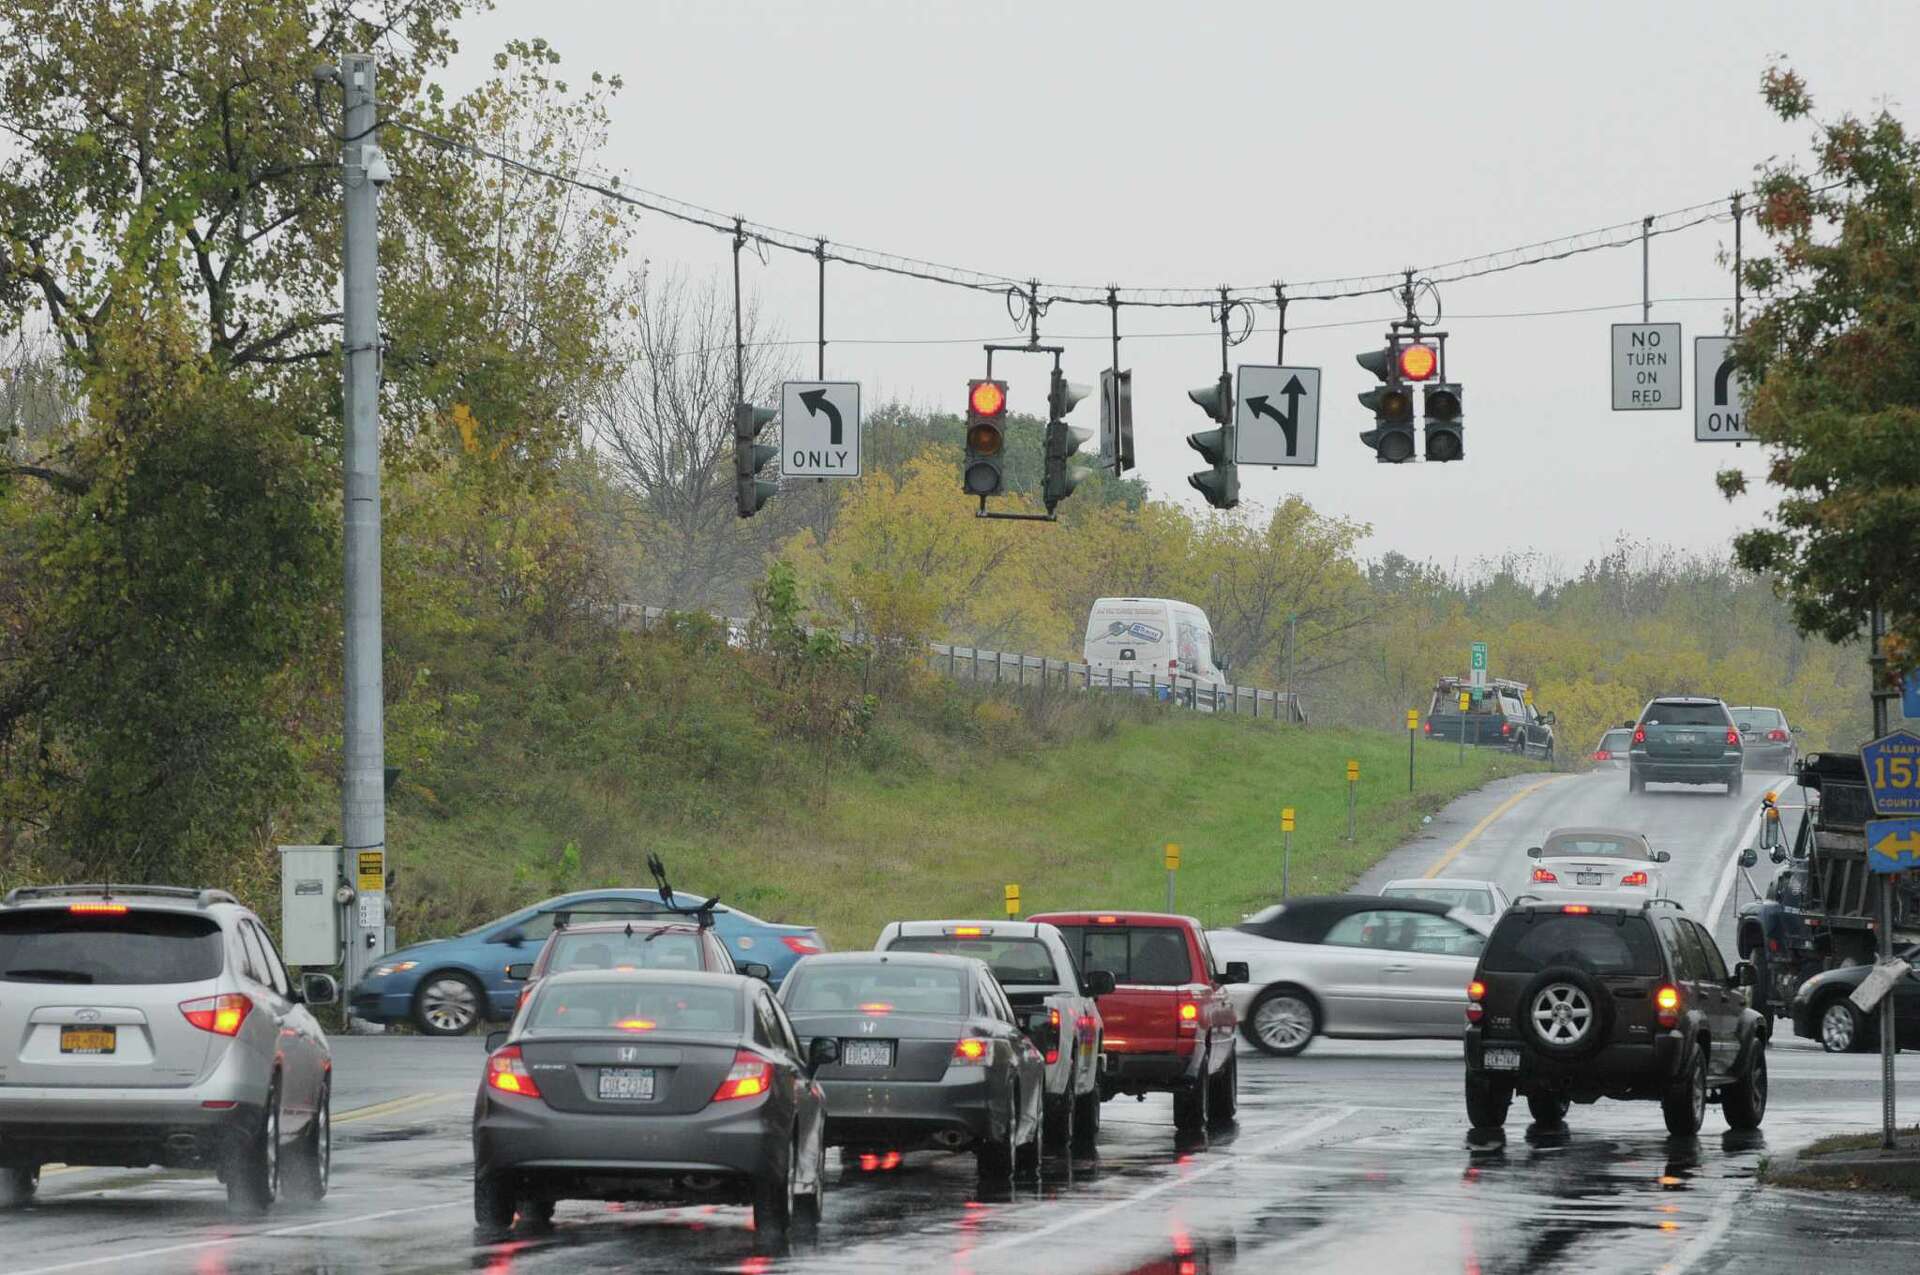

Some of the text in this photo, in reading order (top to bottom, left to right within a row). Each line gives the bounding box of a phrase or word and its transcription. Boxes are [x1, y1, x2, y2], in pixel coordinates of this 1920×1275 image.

[1632, 331, 1661, 347] NO
[1627, 352, 1667, 366] TURN
[1637, 371, 1657, 384] ON
[1632, 390, 1662, 403] RED
[1708, 413, 1749, 432] ON
[793, 450, 848, 468] ONLY
[1474, 652, 1483, 668] 3
